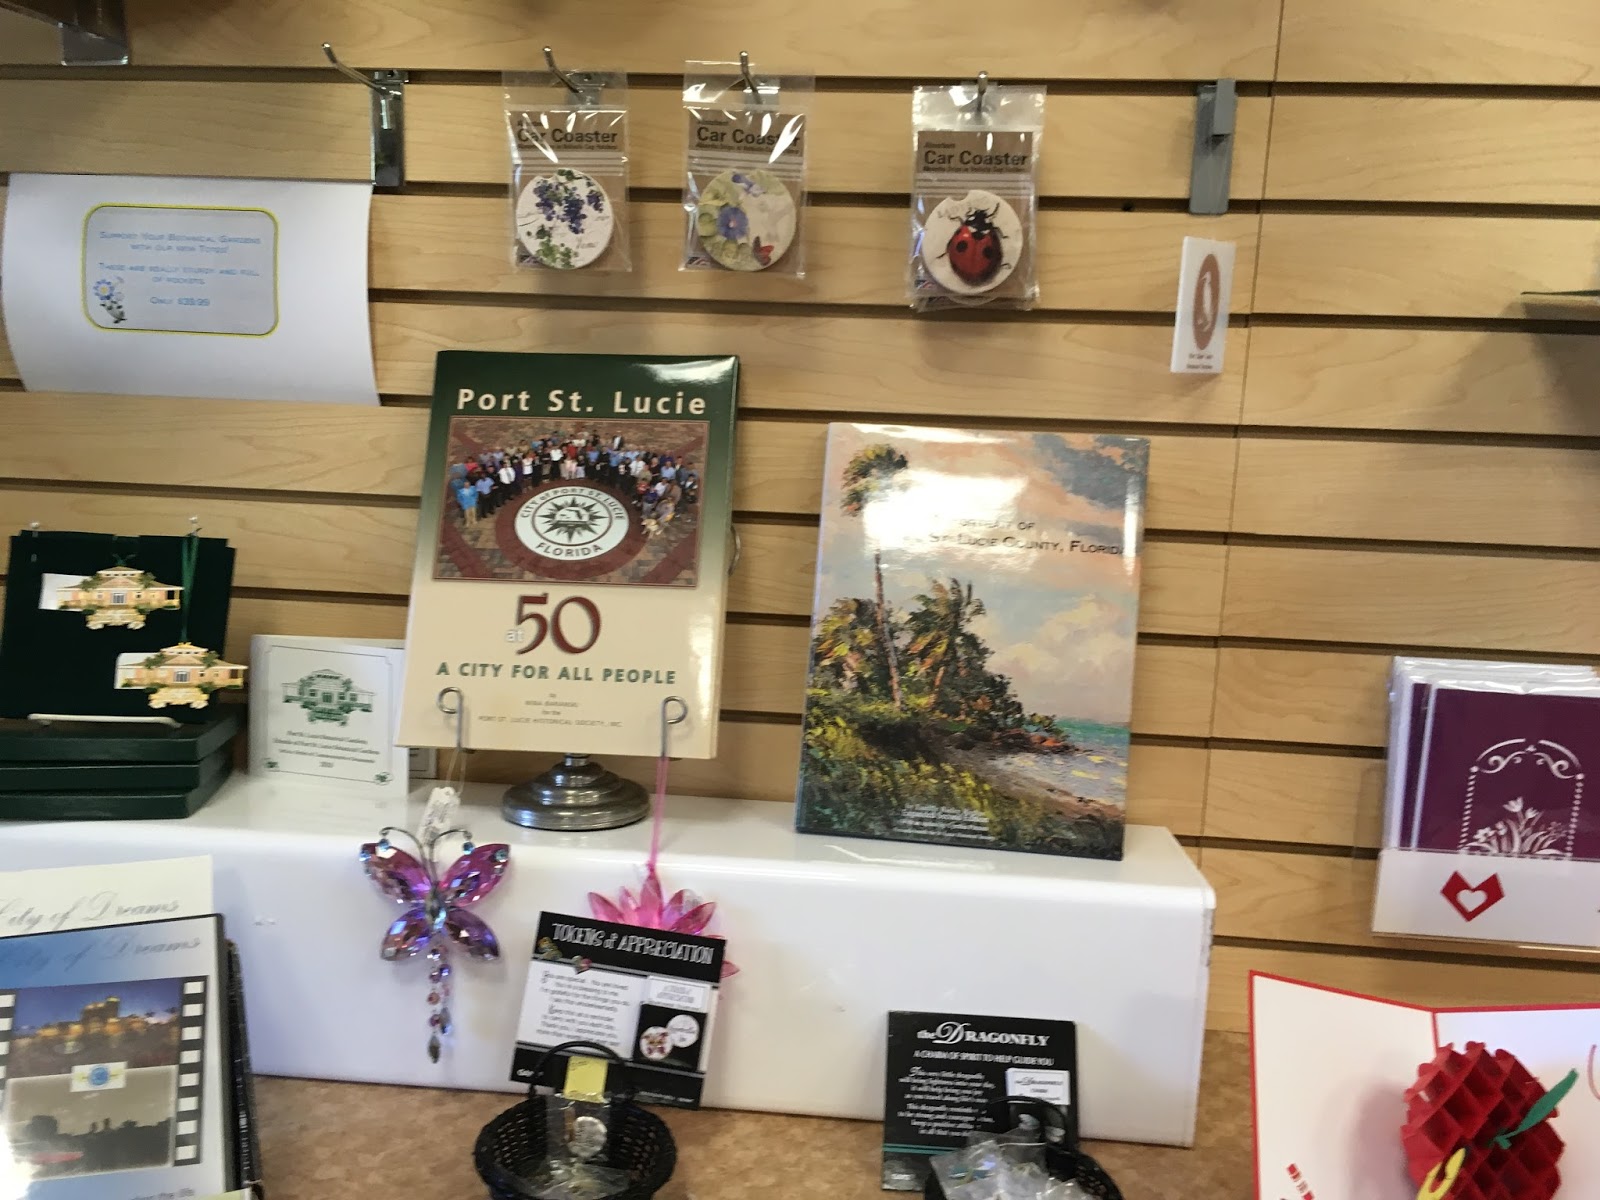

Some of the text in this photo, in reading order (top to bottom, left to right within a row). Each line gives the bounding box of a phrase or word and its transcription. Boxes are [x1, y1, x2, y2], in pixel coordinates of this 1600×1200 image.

[517, 128, 618, 143] Car Coaster
[697, 126, 727, 142] Car
[924, 150, 1028, 166] Car Coaster
[456, 388, 706, 415] Port St. Lucie
[519, 499, 540, 519] CITY
[552, 487, 585, 496] PORT
[603, 497, 626, 520] LUCIE
[1017, 521, 1036, 531] OF
[535, 542, 604, 558] FLORIDA
[956, 533, 999, 549] LUCIE
[1002, 535, 1064, 553] COUNTY,
[515, 592, 602, 655] 50
[506, 628, 525, 642] at
[436, 661, 677, 685] A CITY FOR ALL PEOPLE
[82, 889, 180, 922] Dreams
[551, 922, 605, 947] TOKENS
[618, 934, 715, 965] APPRECIATION
[916, 1021, 1051, 1047] the DRAGONFLY
